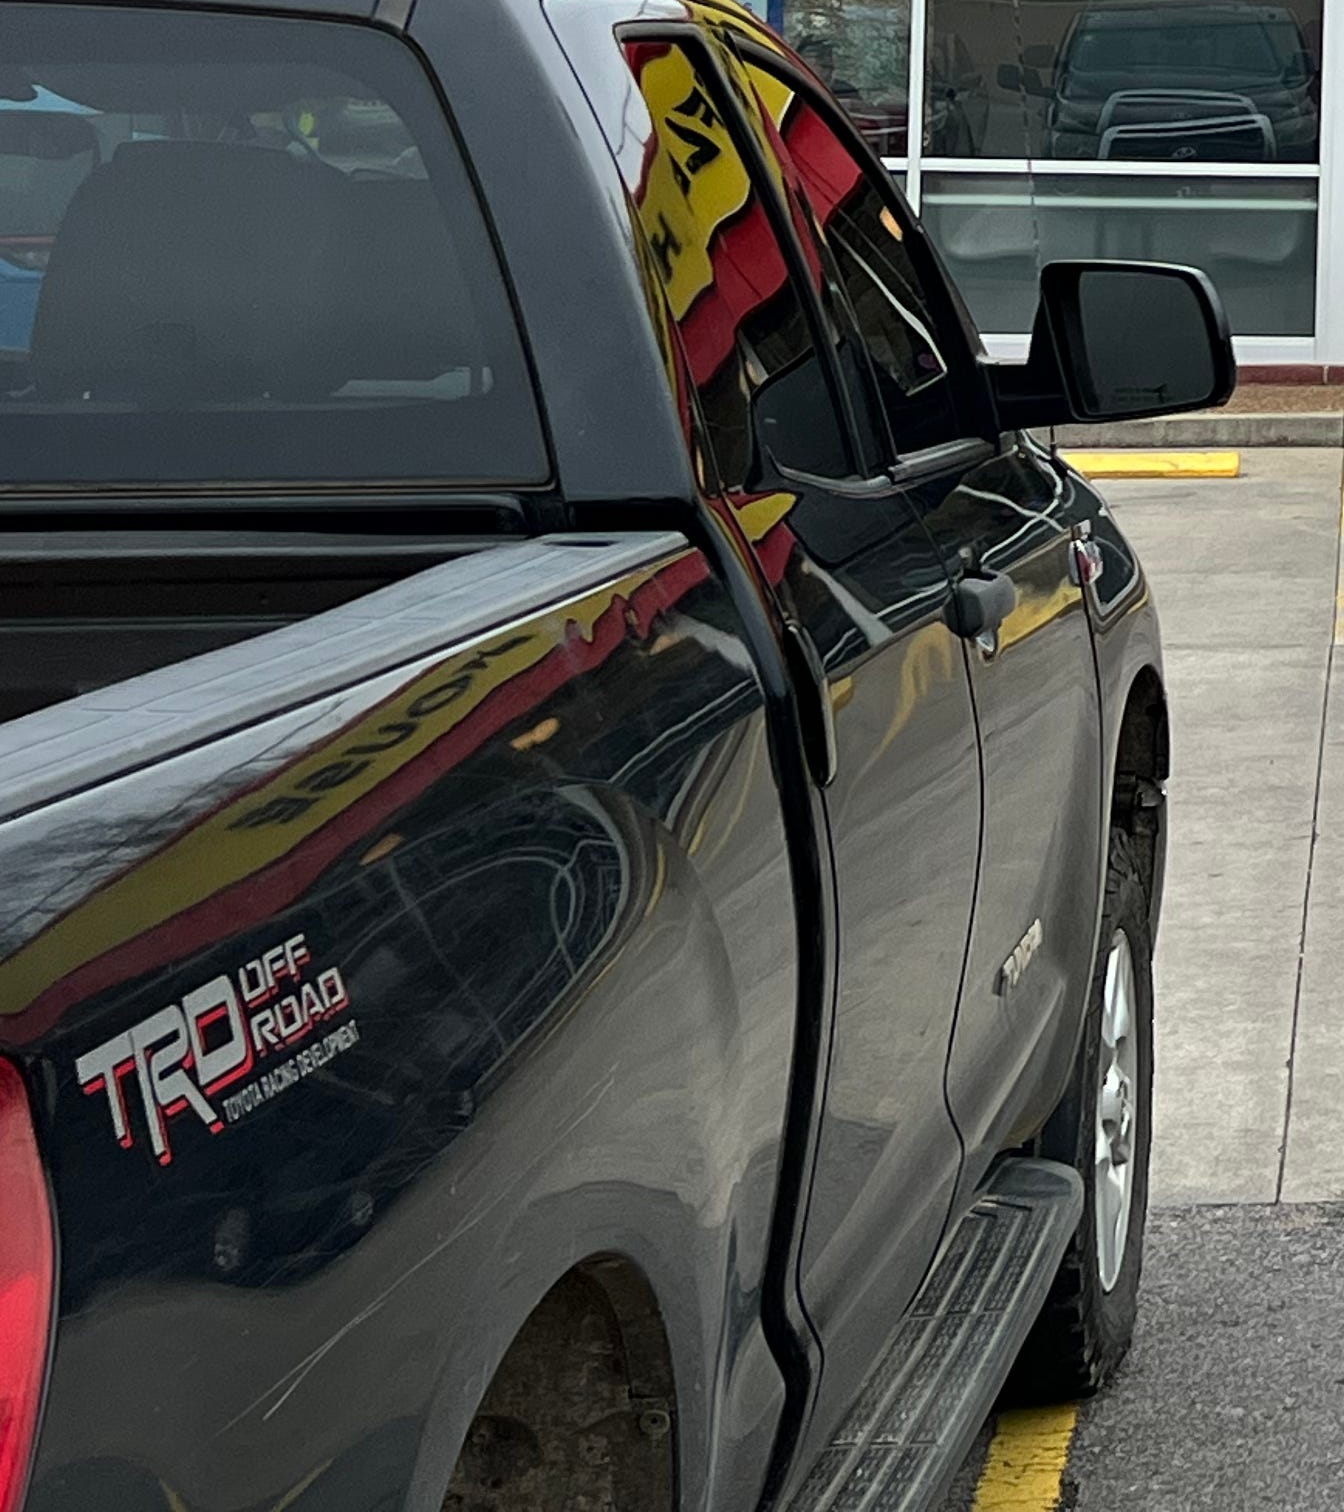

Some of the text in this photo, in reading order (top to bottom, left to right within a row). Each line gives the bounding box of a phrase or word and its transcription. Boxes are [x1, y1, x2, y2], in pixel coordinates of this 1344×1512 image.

[239, 933, 309, 1006] OFF
[250, 967, 348, 1056] ROAD
[75, 974, 252, 1165] TRD
[222, 1081, 264, 1123] TOYOTA
